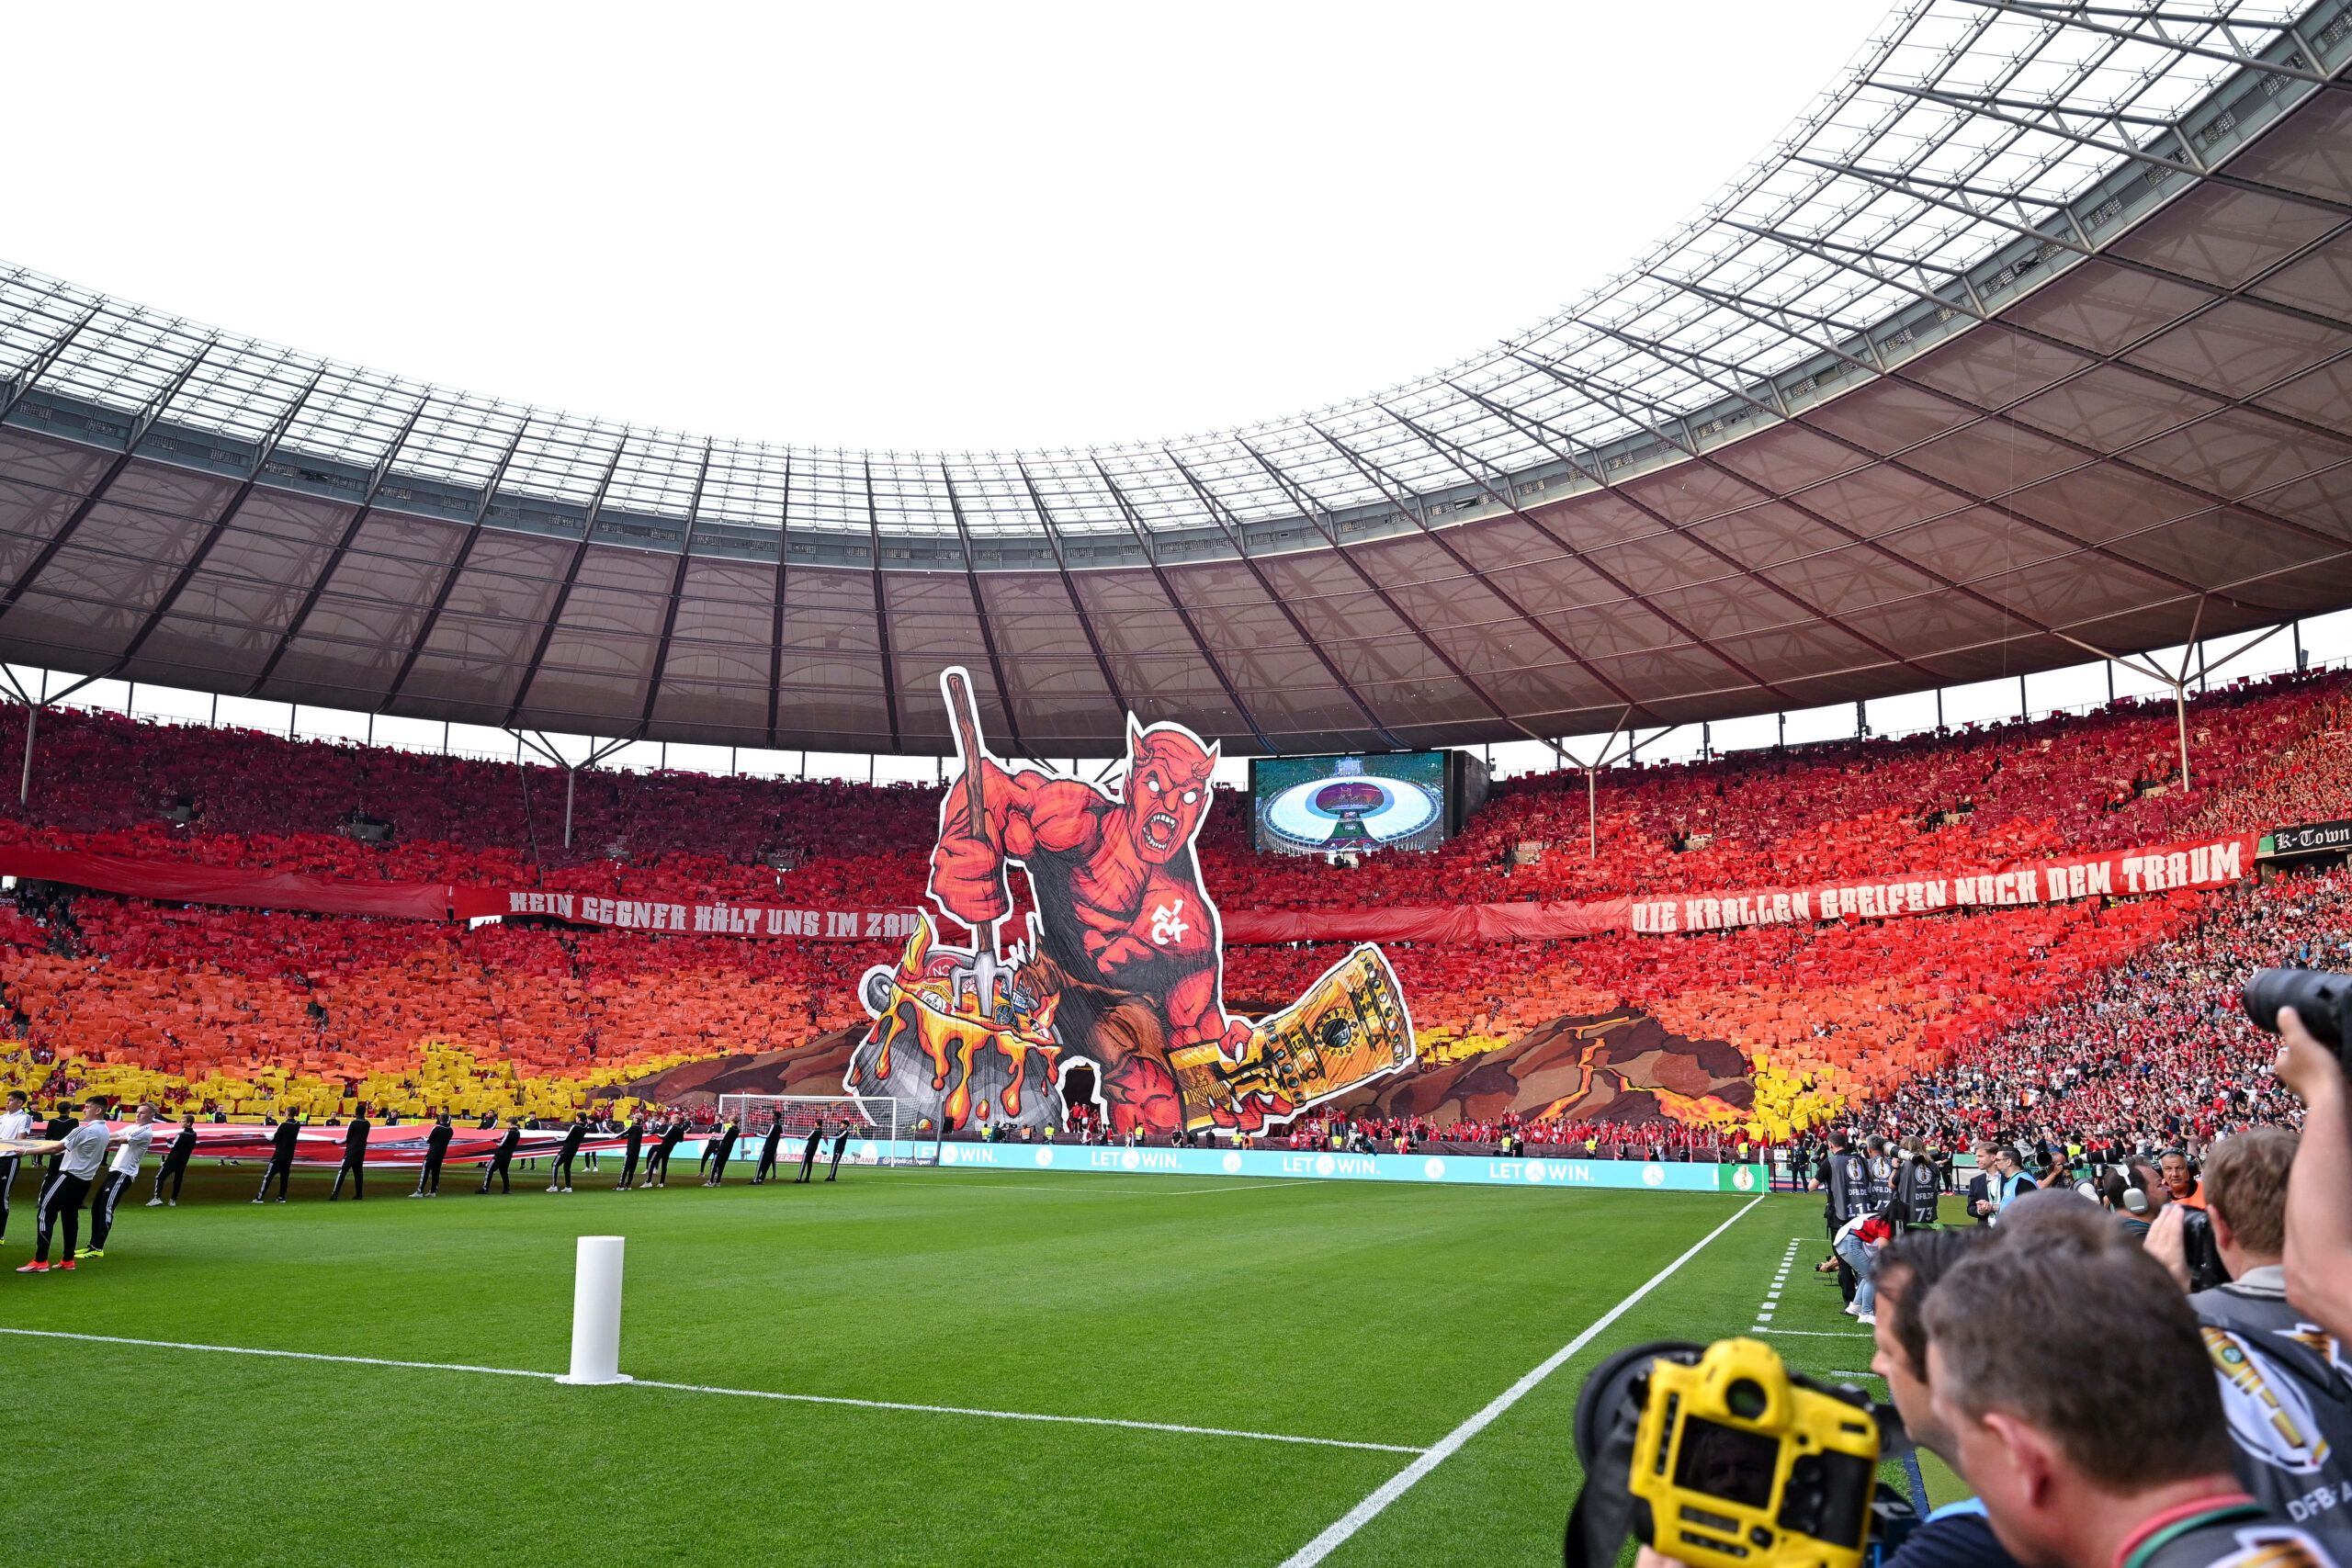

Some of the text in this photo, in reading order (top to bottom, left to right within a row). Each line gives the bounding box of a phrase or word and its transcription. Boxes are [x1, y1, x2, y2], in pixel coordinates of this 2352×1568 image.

[2275, 829, 2350, 851] K-Town
[1632, 841, 2242, 933] DIE KRALLEN GREIFEN NACH DEM TRAUM
[509, 892, 574, 919] KEIN
[581, 897, 687, 931] GEGNER
[694, 901, 762, 934] HÄLT
[766, 908, 820, 937] UNS
[825, 911, 859, 937] IM
[960, 1147, 998, 1163] WIN.
[1091, 1151, 1182, 1168] LET WIN.
[1283, 1157, 1381, 1175] LET WIN.
[1489, 1162, 1595, 1182] LET WIN.
[1916, 1206, 1933, 1223] 73
